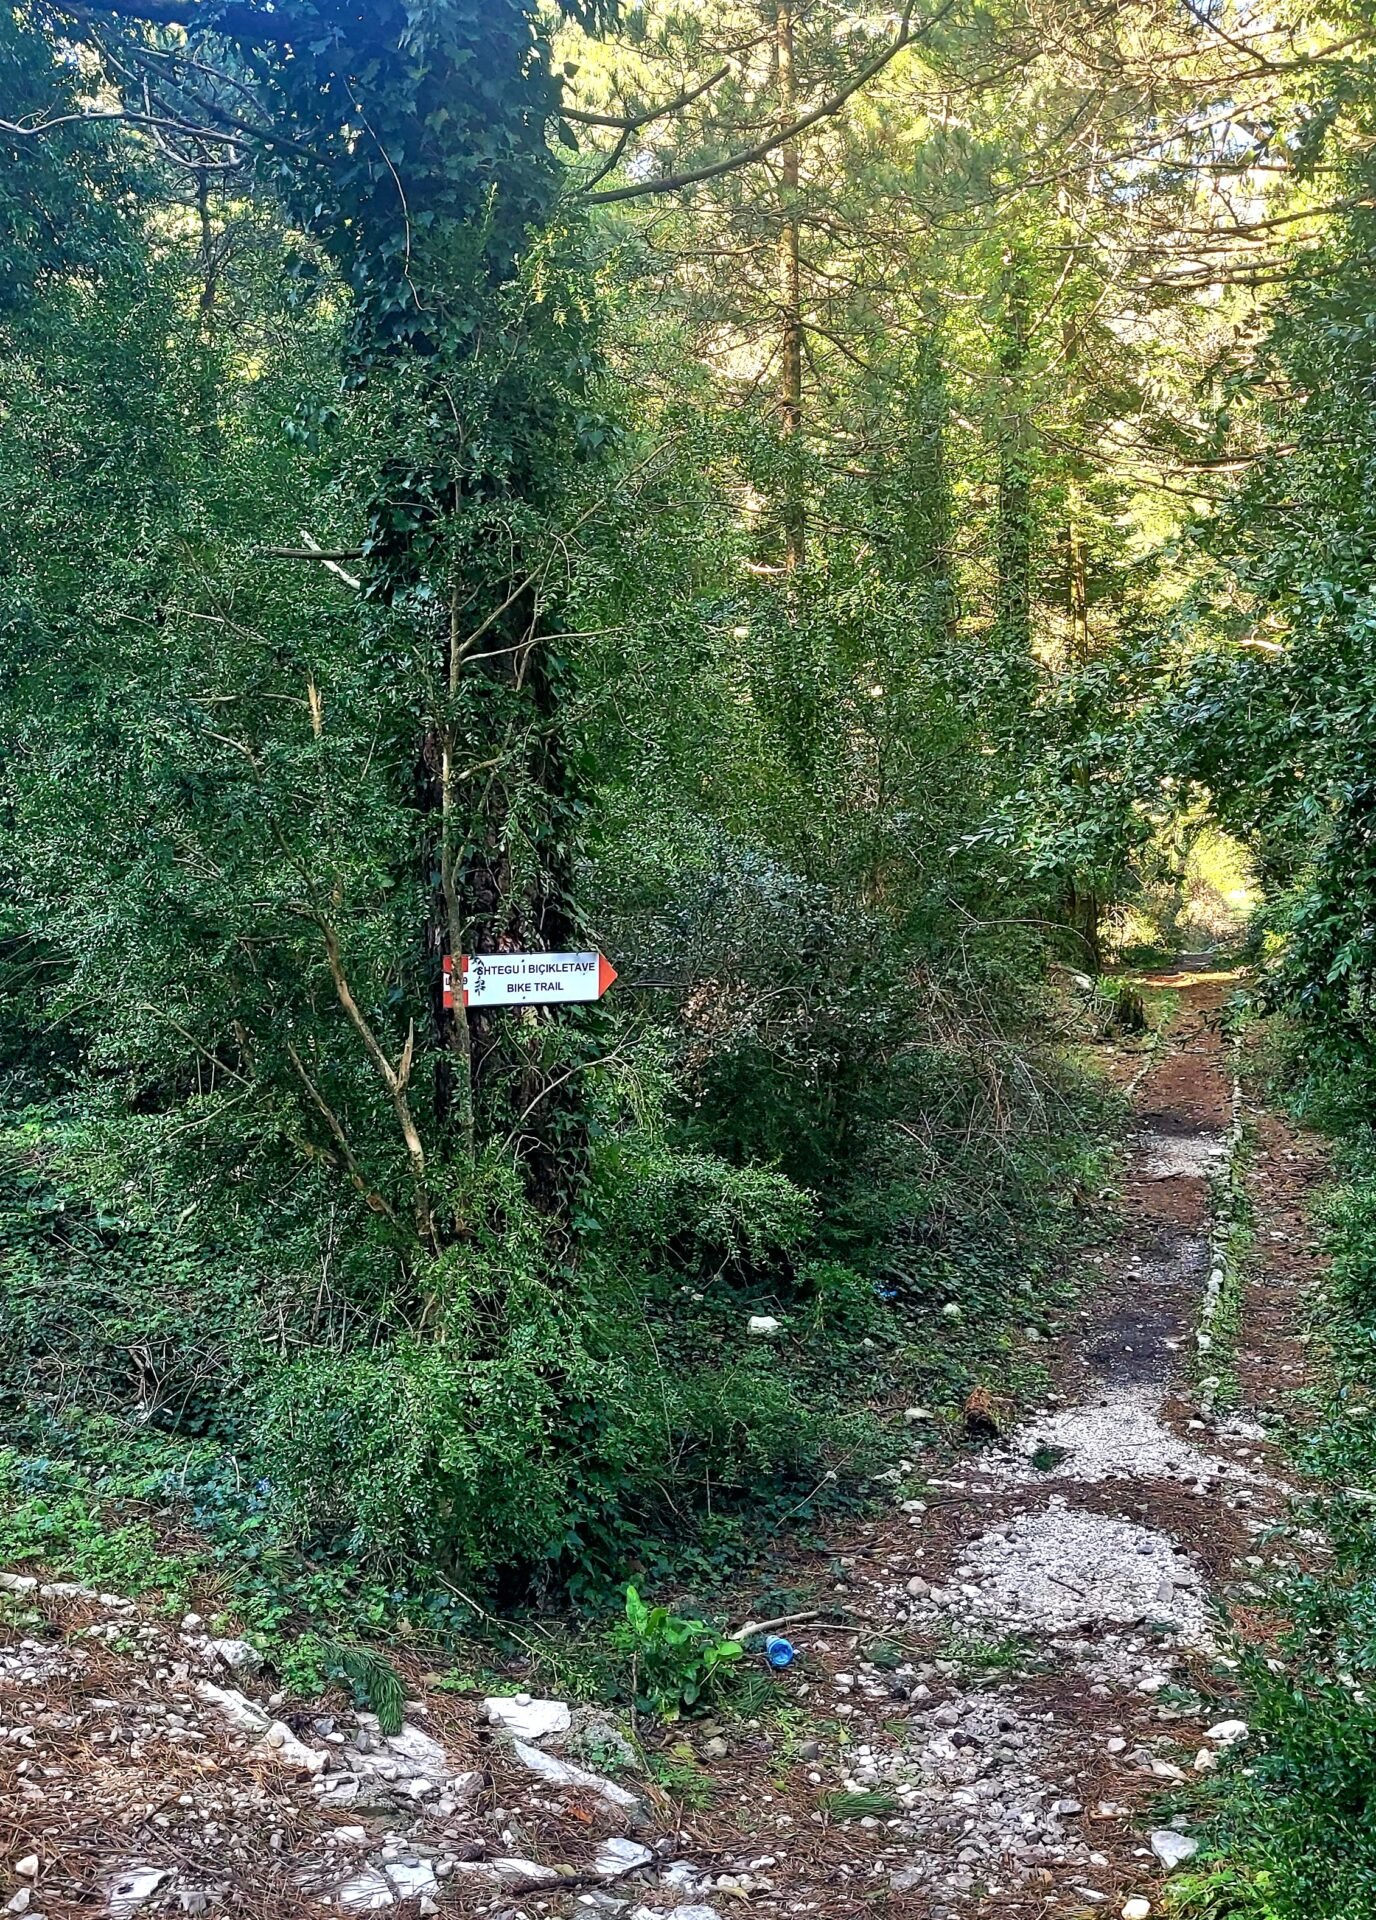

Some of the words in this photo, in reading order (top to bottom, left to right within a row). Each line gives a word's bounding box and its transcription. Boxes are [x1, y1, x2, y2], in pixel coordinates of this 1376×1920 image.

[476, 965, 520, 975] SHTEGU
[522, 964, 526, 974] I
[528, 962, 595, 975] BIÇIKLETAVE
[507, 983, 531, 993] BIKE
[534, 982, 564, 991] TRAIL
